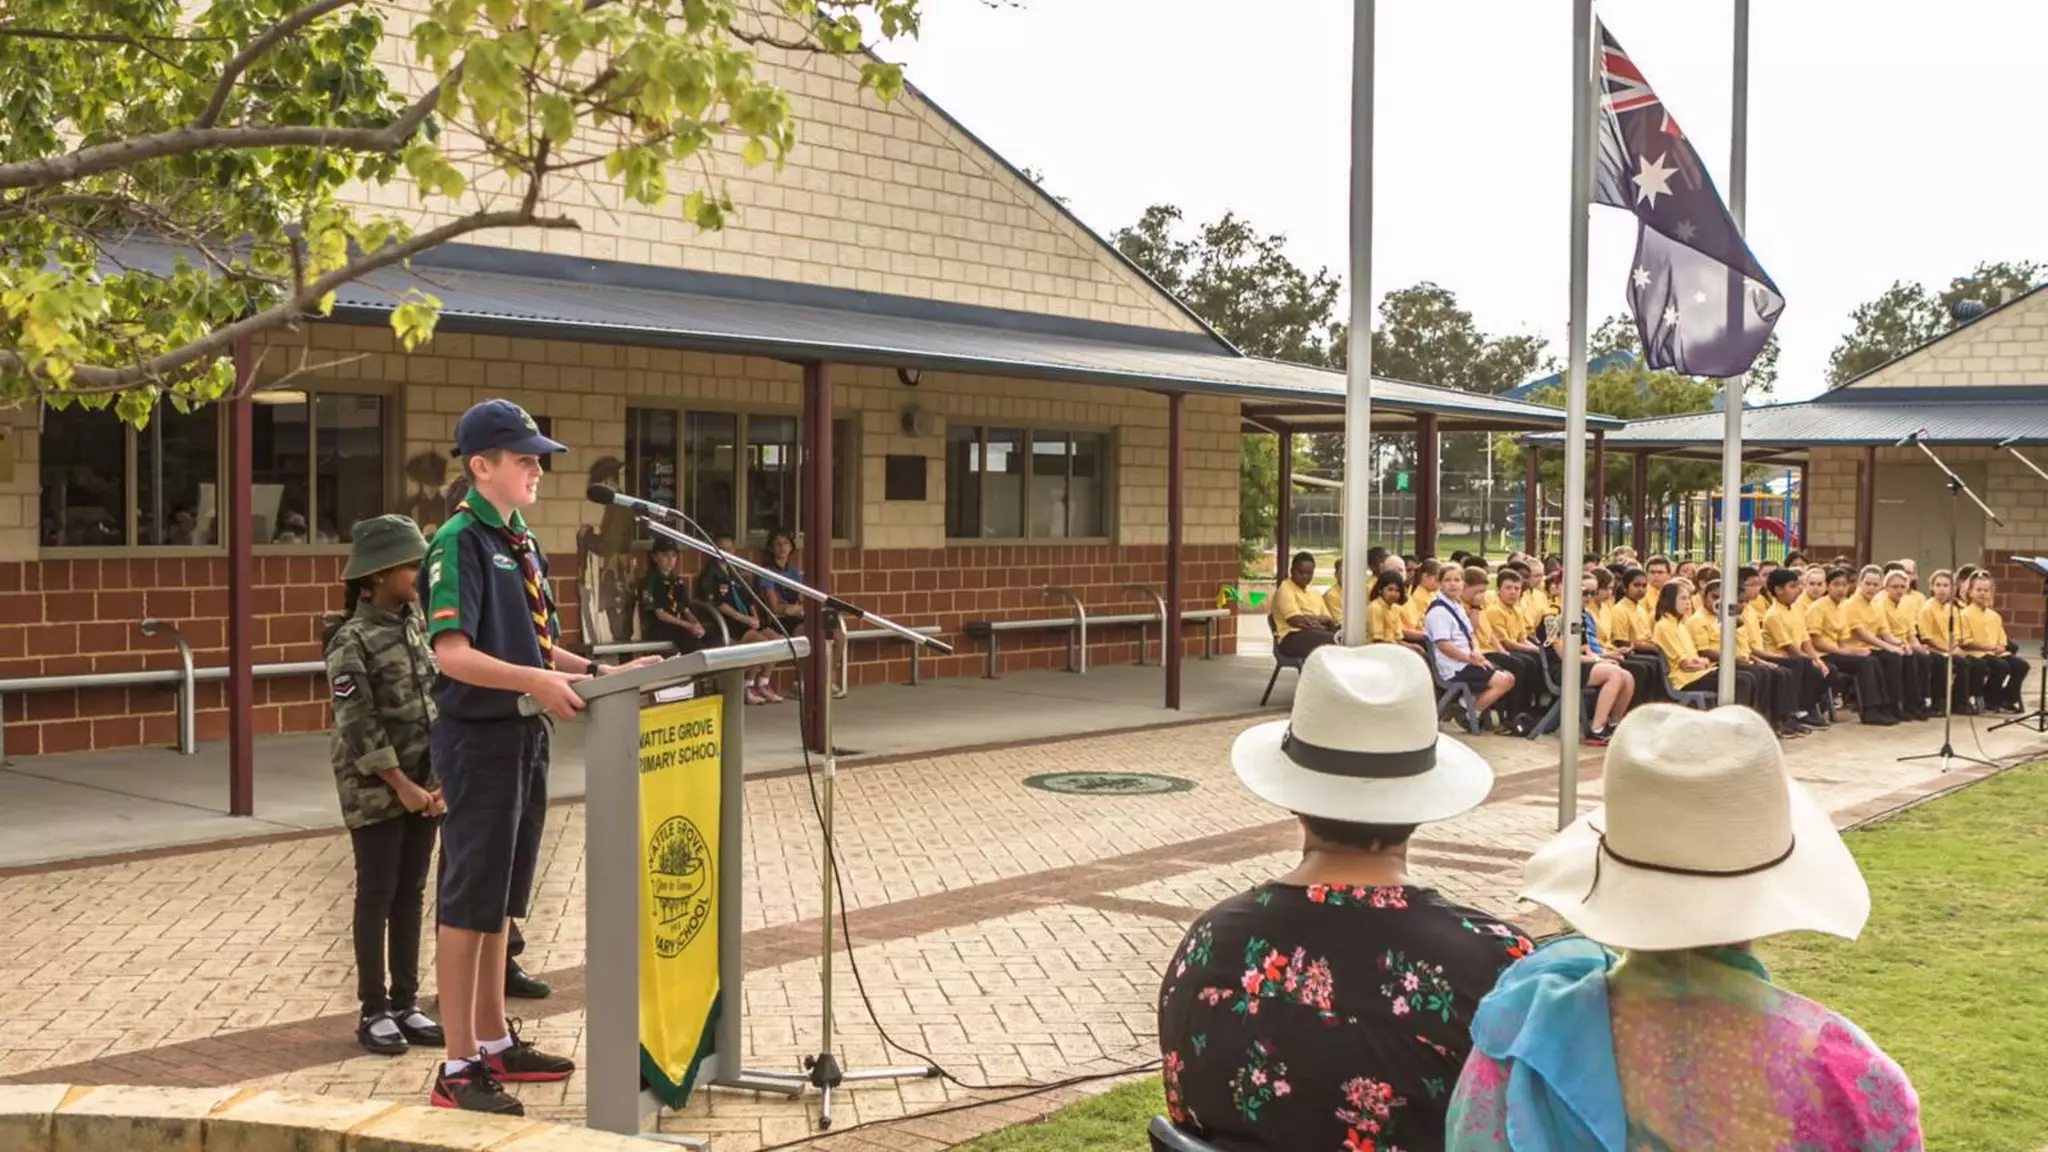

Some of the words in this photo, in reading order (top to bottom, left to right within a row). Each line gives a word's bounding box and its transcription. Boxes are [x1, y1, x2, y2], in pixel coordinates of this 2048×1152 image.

[678, 718, 714, 741] GROVE
[639, 750, 677, 774] RIMARY
[678, 741, 720, 765] SCHOOL
